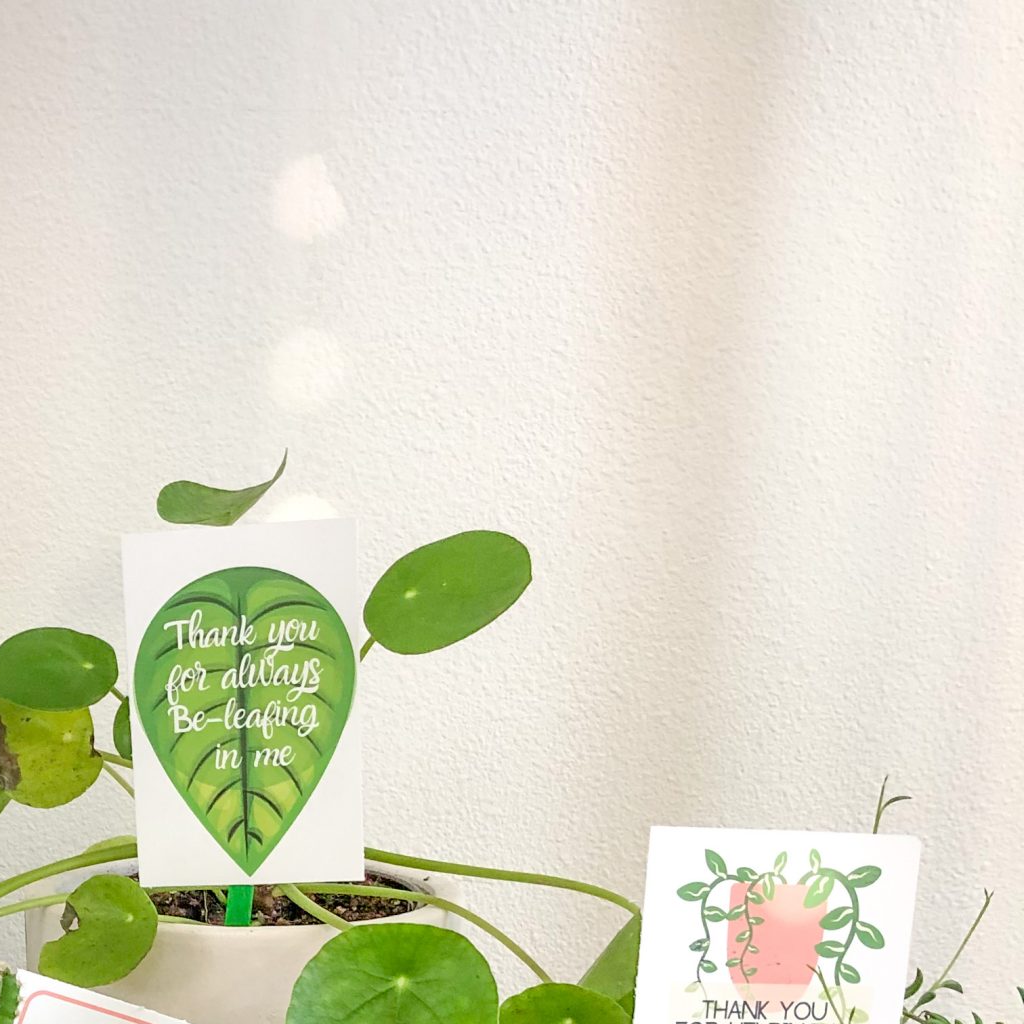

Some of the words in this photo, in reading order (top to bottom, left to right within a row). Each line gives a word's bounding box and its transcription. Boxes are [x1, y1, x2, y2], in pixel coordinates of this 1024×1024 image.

[163, 609, 257, 650] Thank
[263, 618, 320, 660] you
[164, 661, 210, 706] for
[221, 653, 324, 703] always
[167, 697, 319, 739] Be-leafing
[214, 743, 243, 770] in
[253, 745, 296, 768] me
[702, 1000, 770, 1021] THANK
[780, 1001, 829, 1021] YOU
